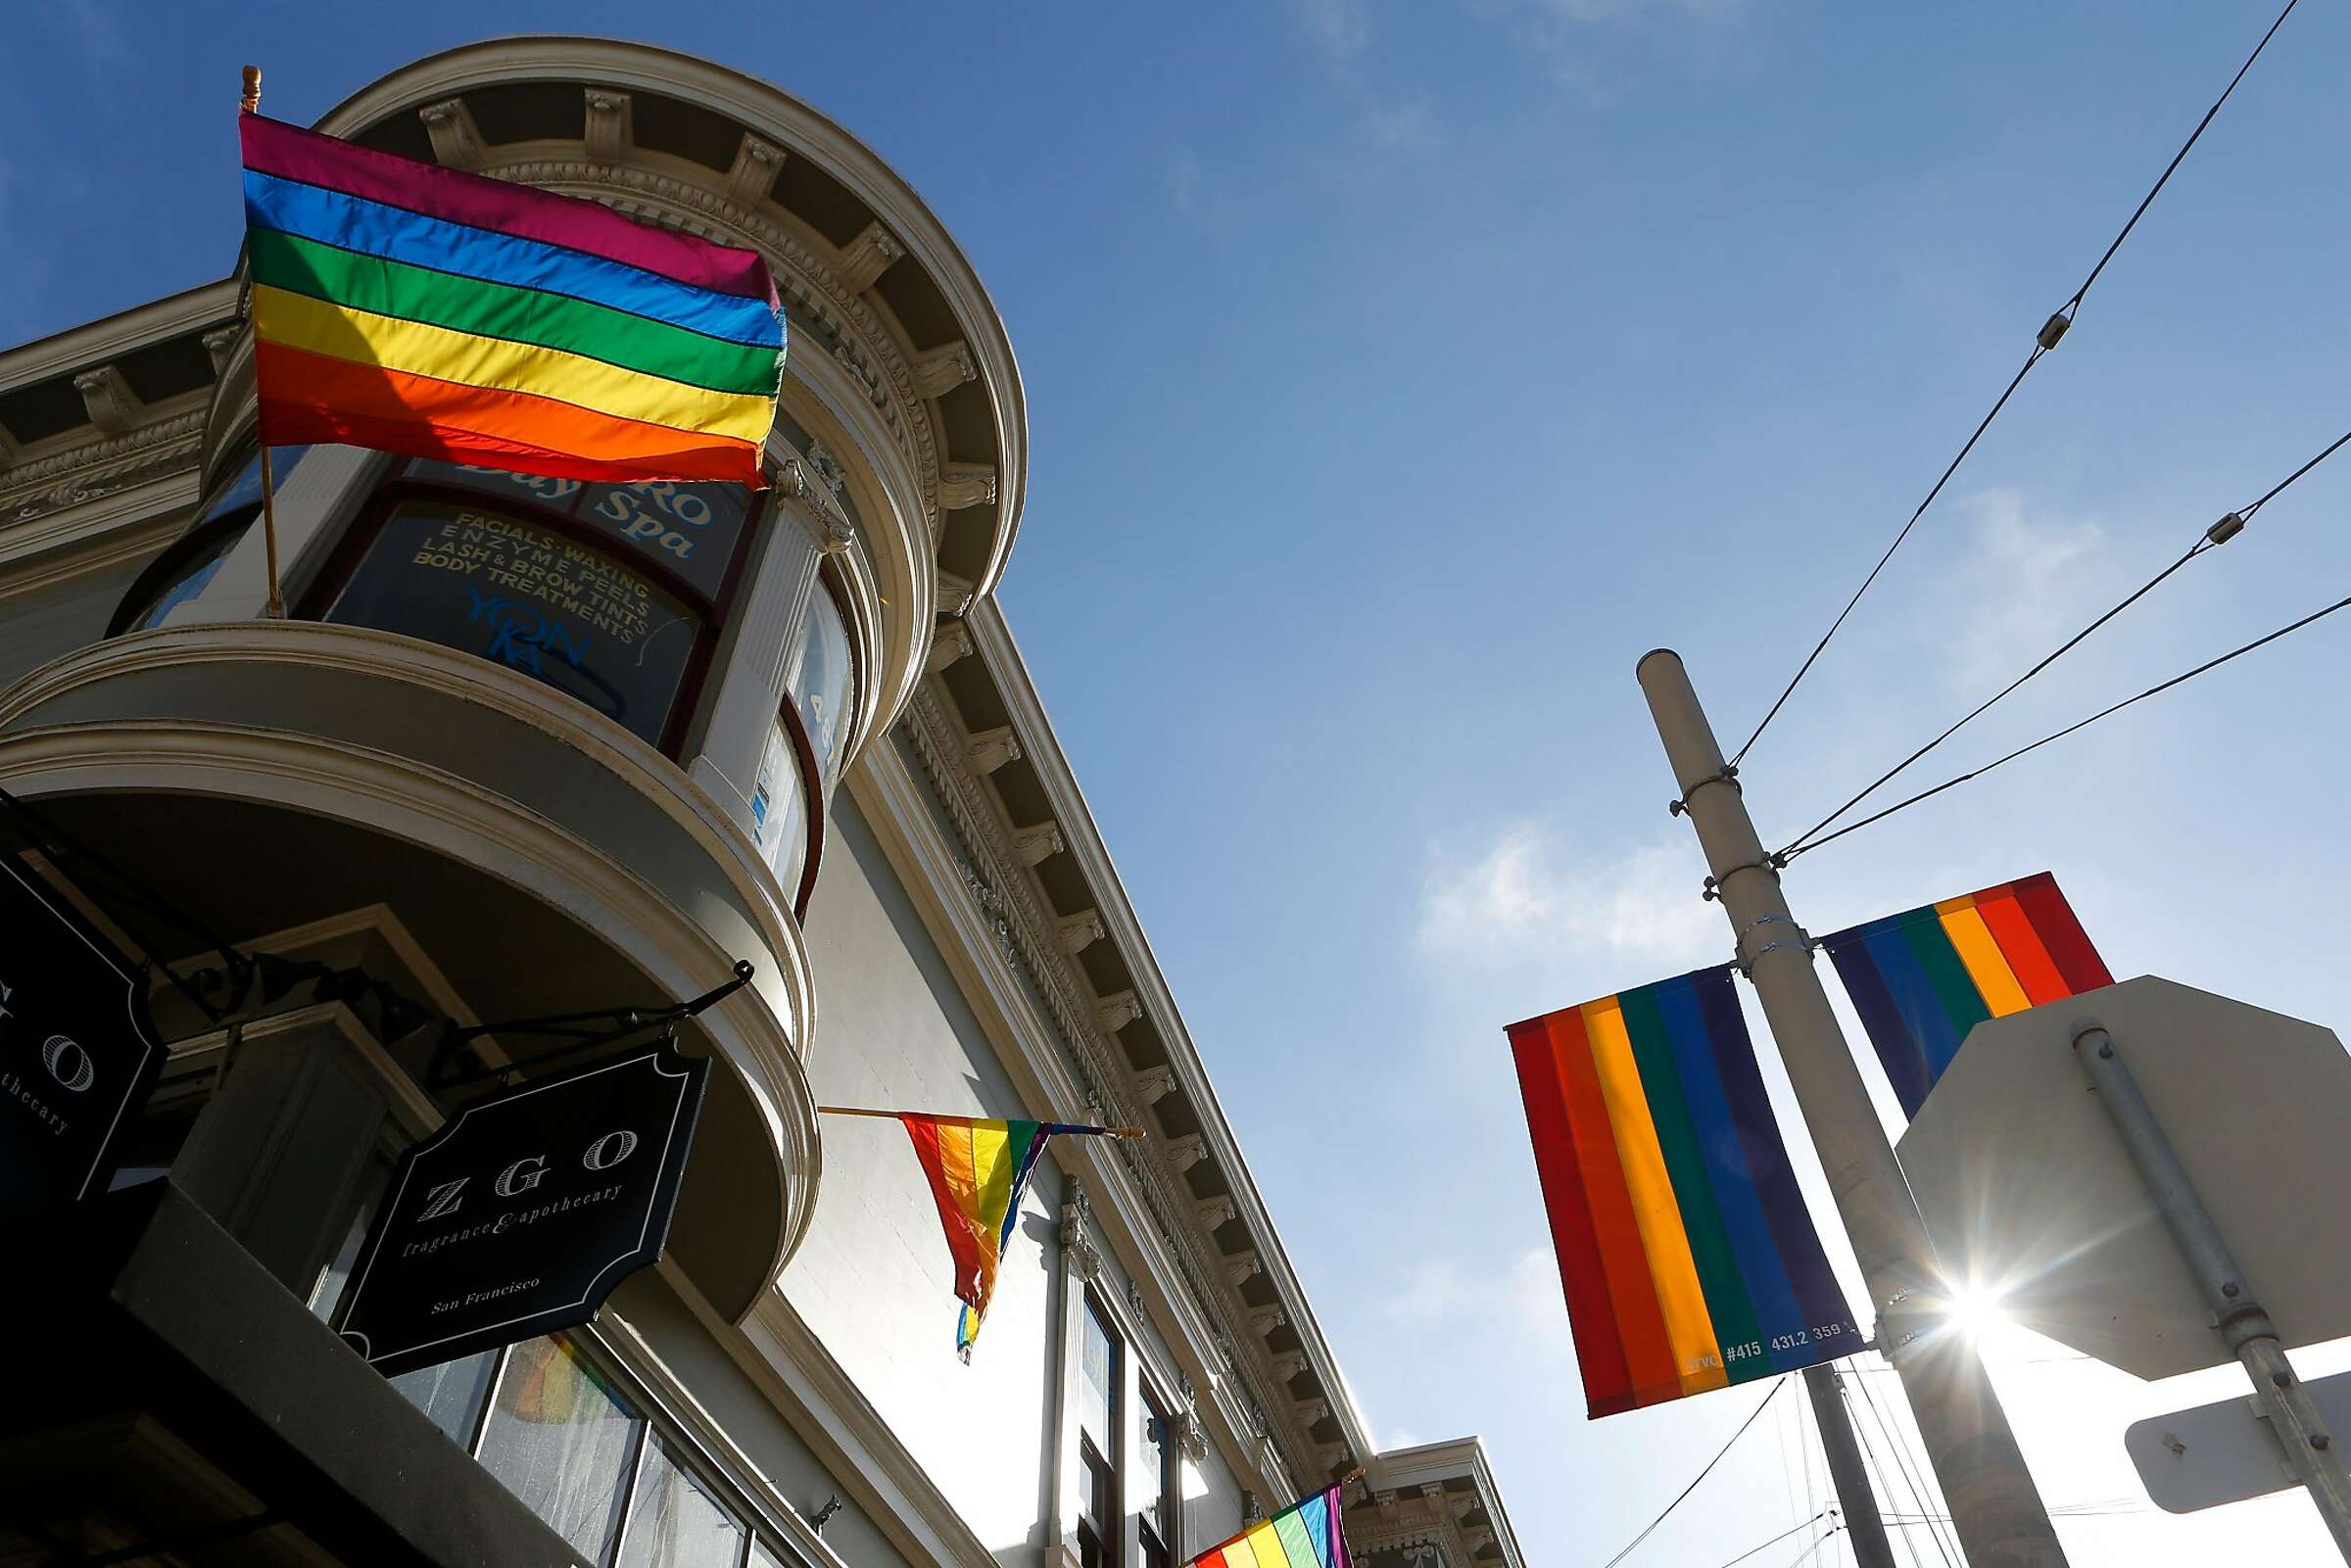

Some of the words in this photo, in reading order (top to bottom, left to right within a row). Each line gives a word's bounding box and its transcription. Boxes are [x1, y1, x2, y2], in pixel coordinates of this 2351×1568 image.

[595, 491, 694, 558] Spa
[412, 551, 481, 574] BODY
[488, 567, 635, 643] TREATMENTS
[422, 538, 491, 562] LASH
[494, 553, 505, 567] &
[510, 558, 584, 595] BROW
[589, 591, 648, 636] TINTS
[440, 525, 571, 574] ENZYME
[579, 569, 649, 617] PEELS
[403, 1222, 490, 1258] fragrance
[519, 1184, 623, 1224] apothecary
[431, 1300, 459, 1314] San
[465, 1277, 540, 1306] Francisco
